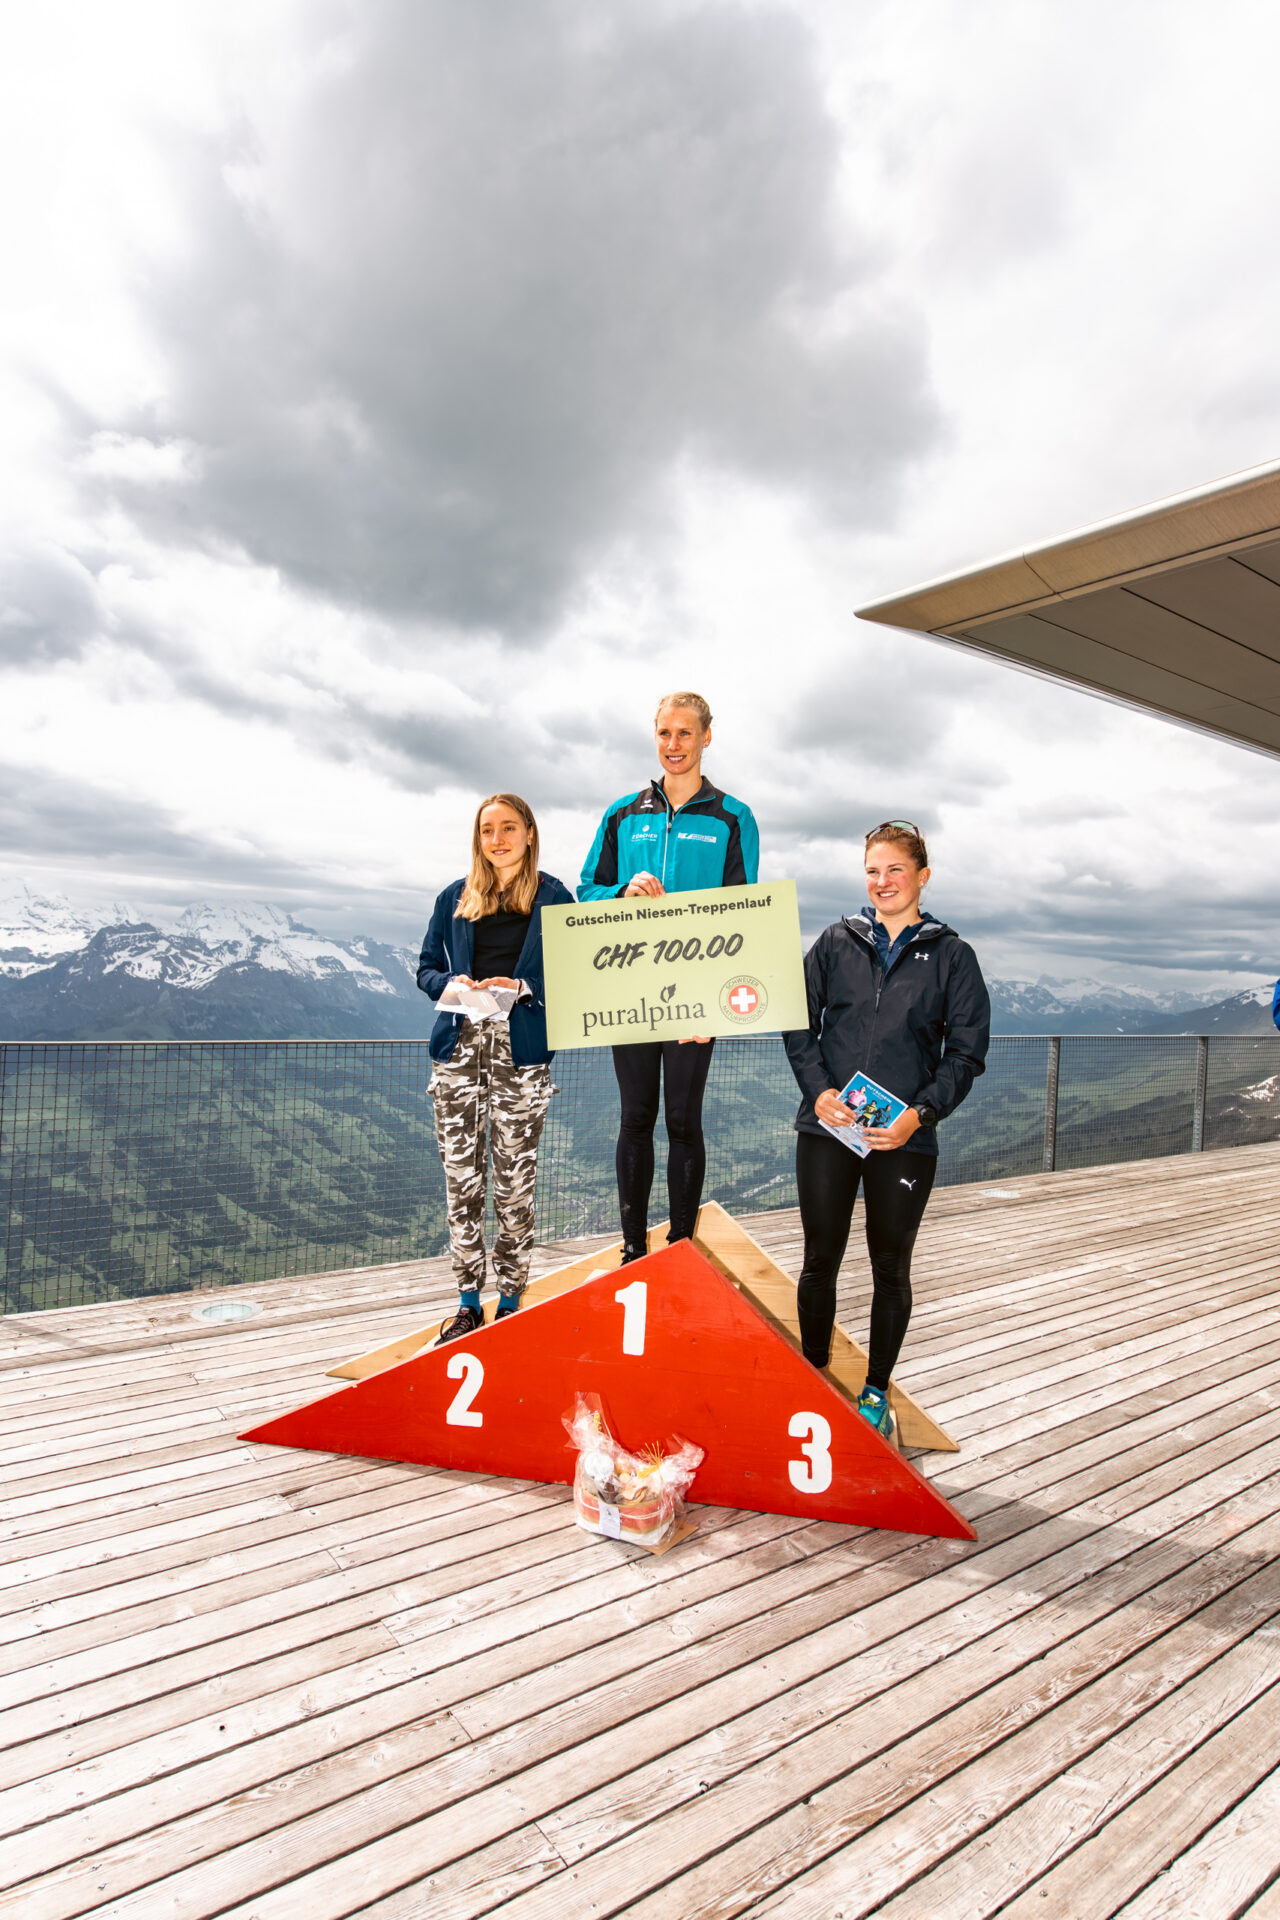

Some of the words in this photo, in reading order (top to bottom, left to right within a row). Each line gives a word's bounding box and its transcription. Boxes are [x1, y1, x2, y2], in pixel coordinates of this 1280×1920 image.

[565, 910, 633, 928] Gutschein
[636, 895, 772, 921] Niesen-Treppenlauf
[592, 941, 649, 971] CHF
[653, 932, 744, 965] 100.00
[725, 977, 760, 990] SCHWEIZER
[582, 996, 707, 1037] puralpina
[614, 1280, 648, 1357] 1
[445, 1352, 485, 1428] 2
[787, 1411, 833, 1494] 3
